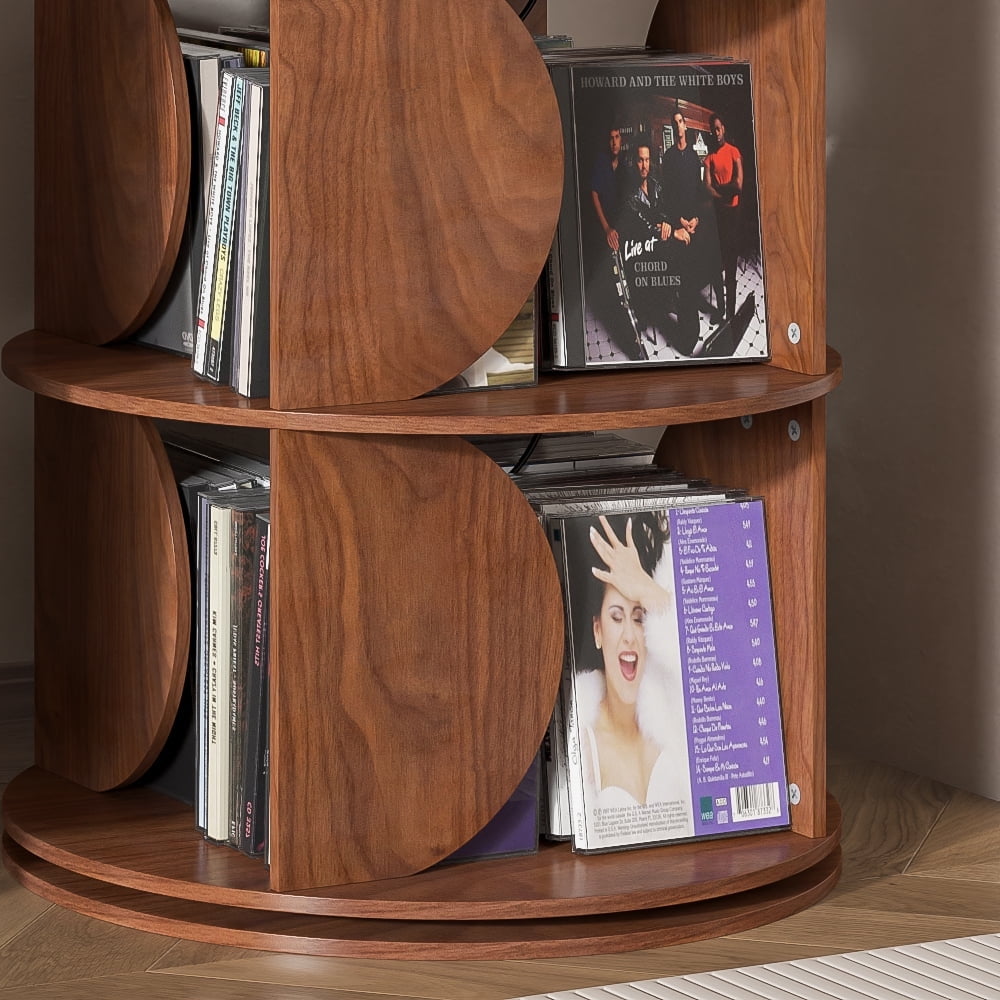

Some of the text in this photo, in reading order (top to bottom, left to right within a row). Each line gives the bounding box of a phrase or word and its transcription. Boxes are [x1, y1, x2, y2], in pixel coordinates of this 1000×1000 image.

[580, 74, 744, 89] HOWARD AND THE WHITE BOYS
[232, 108, 241, 133] BECK
[230, 145, 238, 163] THE
[225, 185, 233, 212] TOWN
[220, 214, 231, 262] PLAYBOYS
[624, 236, 659, 261] Live at
[634, 261, 667, 273] CHORD
[635, 275, 681, 288] ON BLUES
